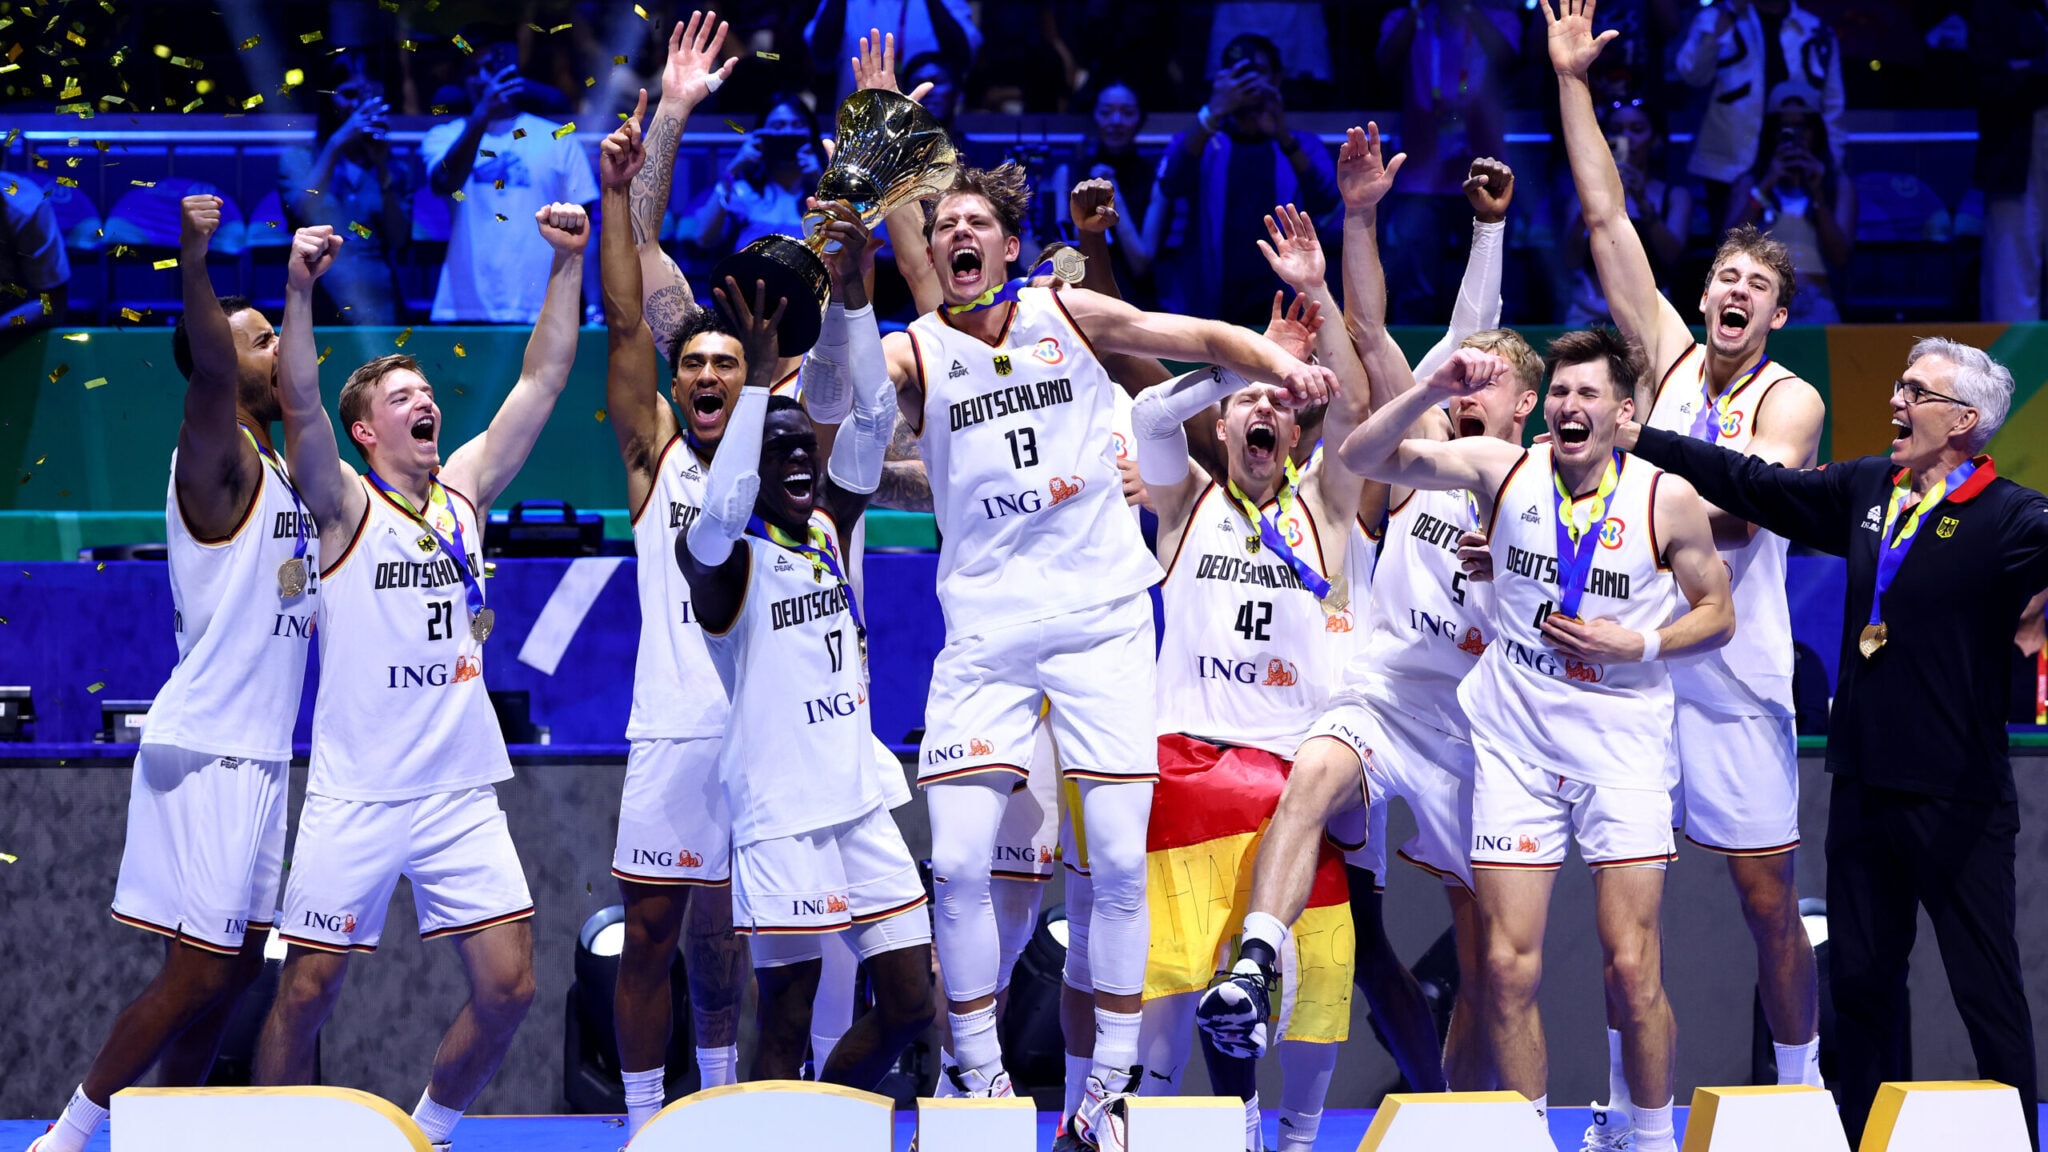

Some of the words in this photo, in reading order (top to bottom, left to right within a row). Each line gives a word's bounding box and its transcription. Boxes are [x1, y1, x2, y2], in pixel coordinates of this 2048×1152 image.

[948, 366, 970, 379] PEAK
[949, 378, 1073, 432] DEUTSCHLAND
[1004, 427, 1039, 469] 13
[980, 489, 1042, 520] ING
[1521, 512, 1541, 524] PEAK
[1452, 571, 1468, 607] 5
[427, 600, 452, 641] 21
[1234, 600, 1273, 641] 42
[1409, 608, 1457, 643] ING
[824, 629, 842, 673] 17
[1506, 640, 1558, 677] ING
[387, 663, 448, 689] ING
[1197, 655, 1258, 684] ING
[803, 692, 856, 725] ING
[927, 743, 964, 765] ING
[632, 848, 673, 868] ING
[995, 846, 1036, 862] ING
[1475, 835, 1512, 851] ING
[304, 910, 341, 932] ING
[792, 899, 825, 916] ING
